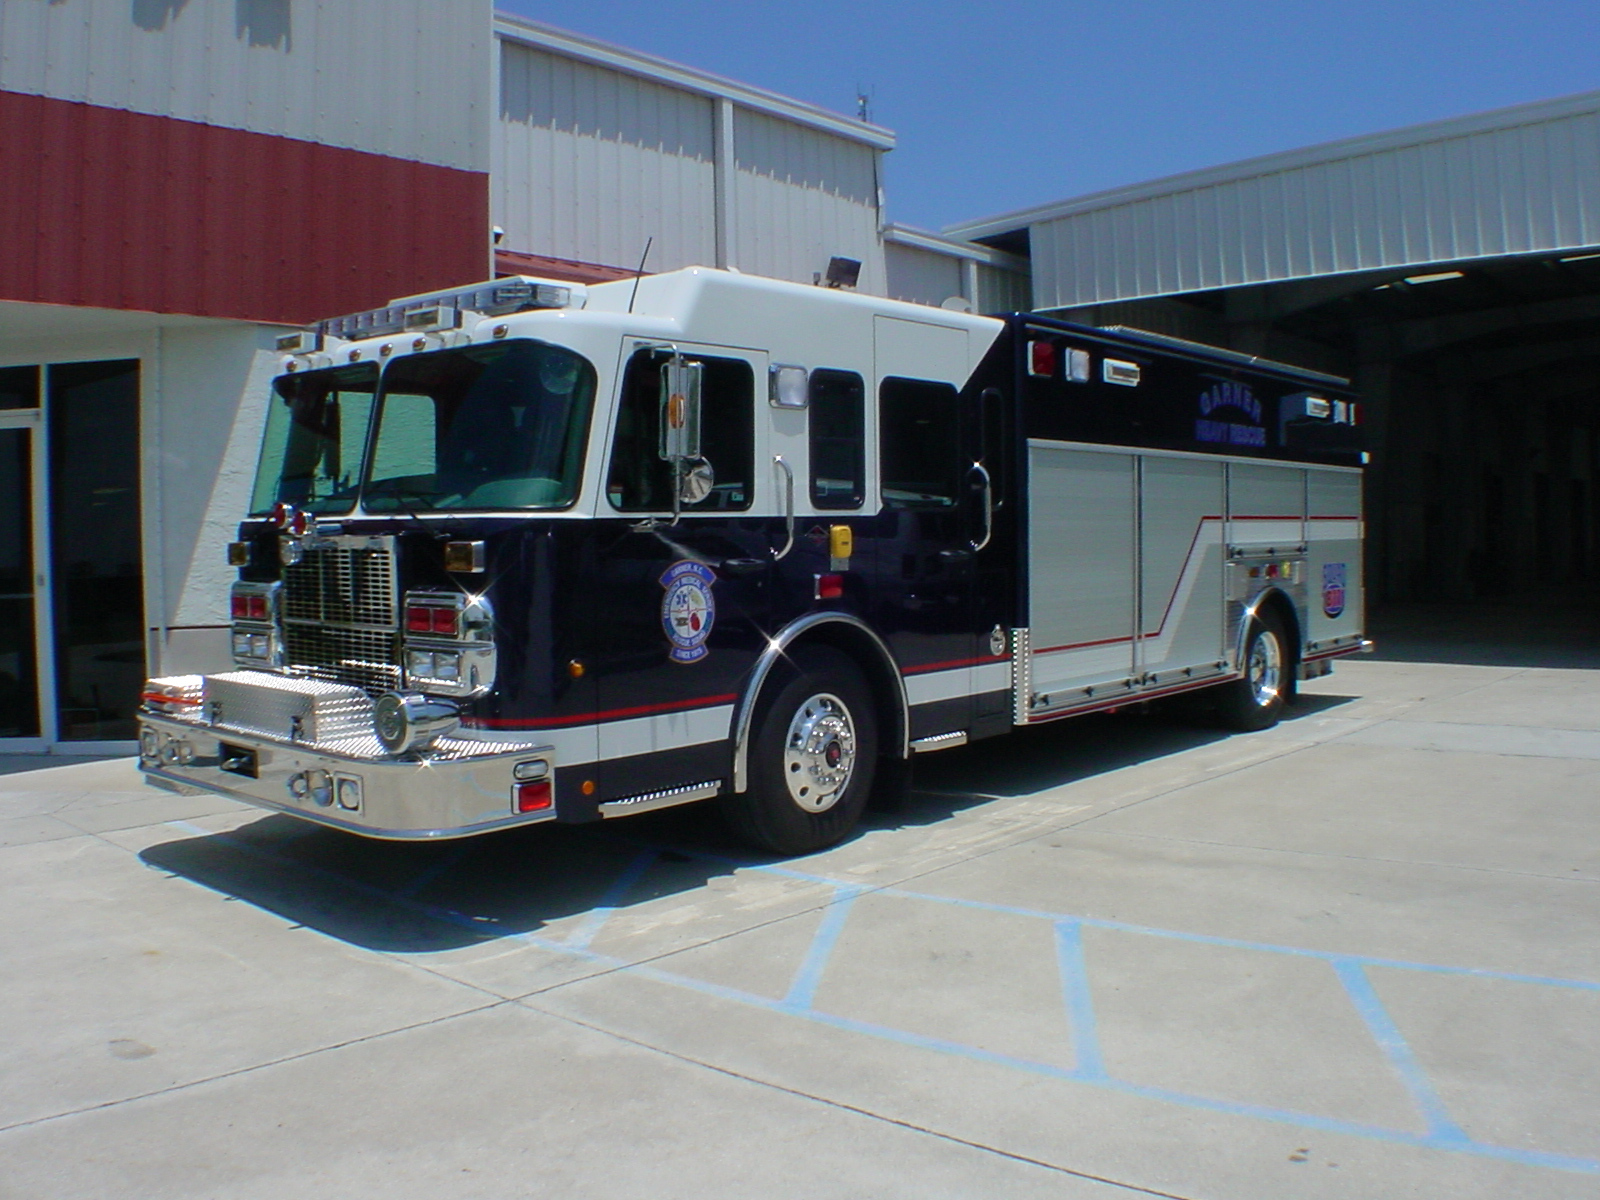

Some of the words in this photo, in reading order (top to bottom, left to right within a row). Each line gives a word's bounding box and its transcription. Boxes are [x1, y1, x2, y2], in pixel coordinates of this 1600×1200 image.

[1199, 382, 1262, 424] GARNER
[1195, 419, 1228, 443] HEAVY
[1229, 423, 1267, 447] RESCUE
